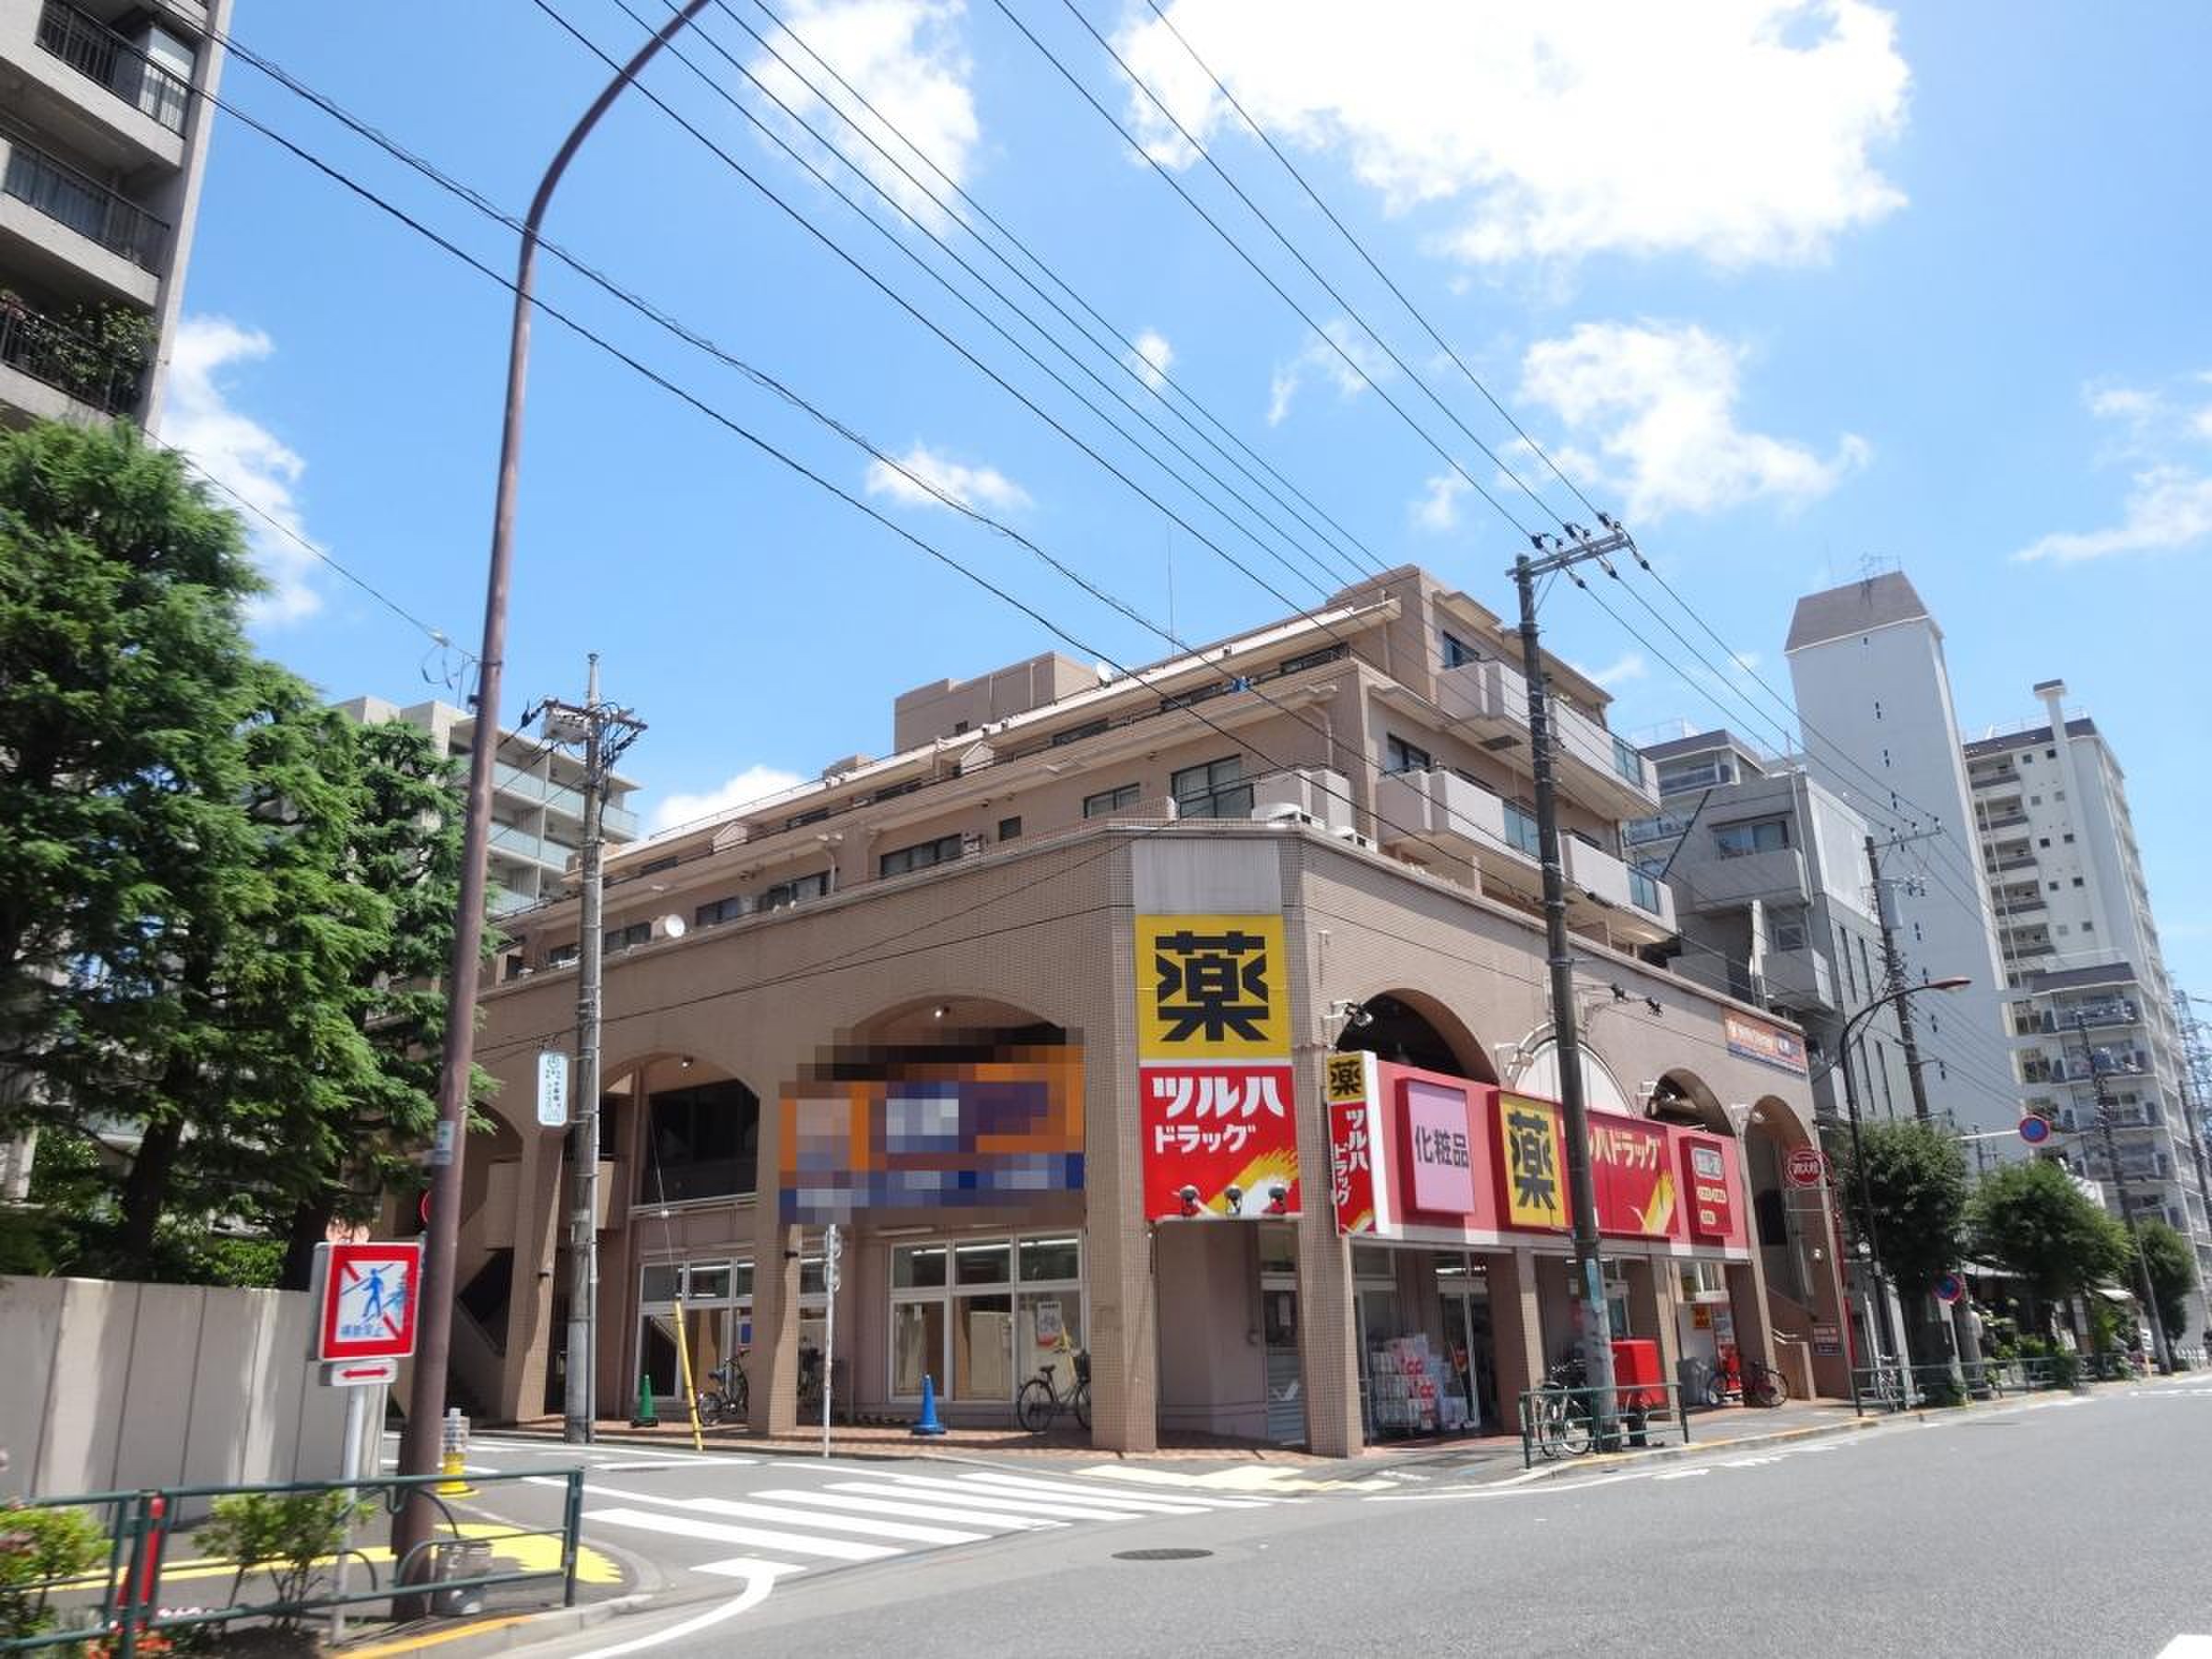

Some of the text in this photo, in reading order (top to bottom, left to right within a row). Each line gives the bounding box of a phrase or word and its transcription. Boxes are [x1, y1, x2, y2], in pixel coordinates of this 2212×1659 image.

[1155, 930, 1269, 1041] 薬
[1152, 1077, 1285, 1118] ツルハ
[1330, 1061, 1361, 1095] 薬
[1155, 1124, 1256, 1154] ドラッグ
[1346, 1109, 1370, 1171] ツルハ
[1415, 1124, 1470, 1169] 化粧品
[1507, 1110, 1556, 1210] 薬
